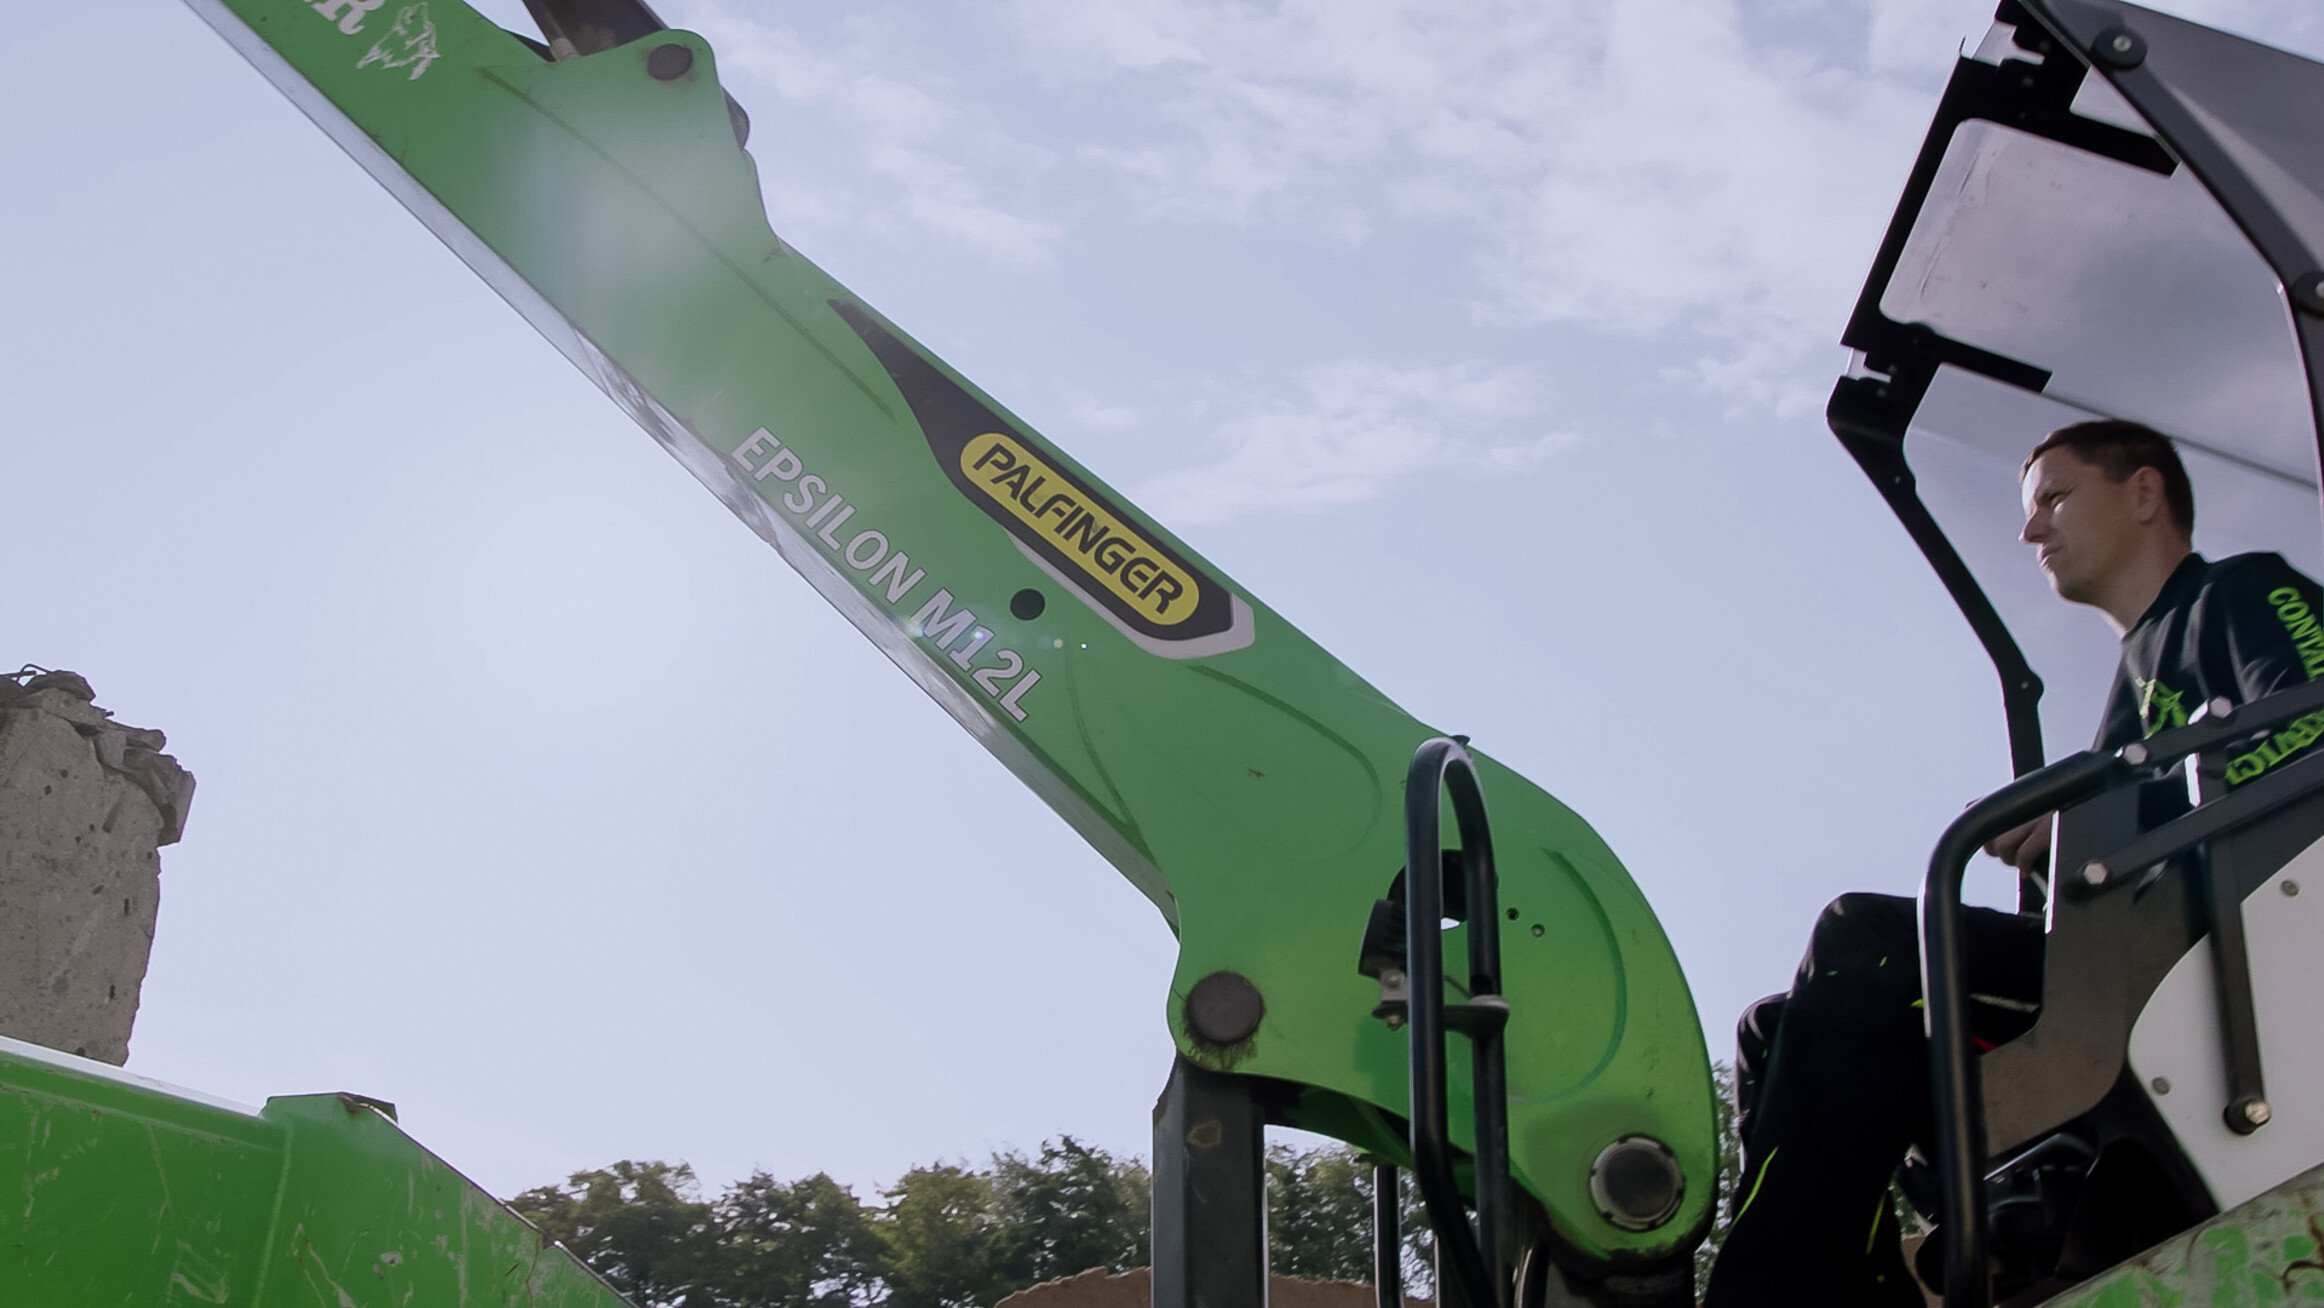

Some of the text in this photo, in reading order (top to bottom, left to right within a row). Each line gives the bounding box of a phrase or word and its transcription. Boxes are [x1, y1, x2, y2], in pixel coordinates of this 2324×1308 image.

[730, 426, 1044, 724] EPSILON M12L
[972, 443, 1185, 615] PALFINGER
